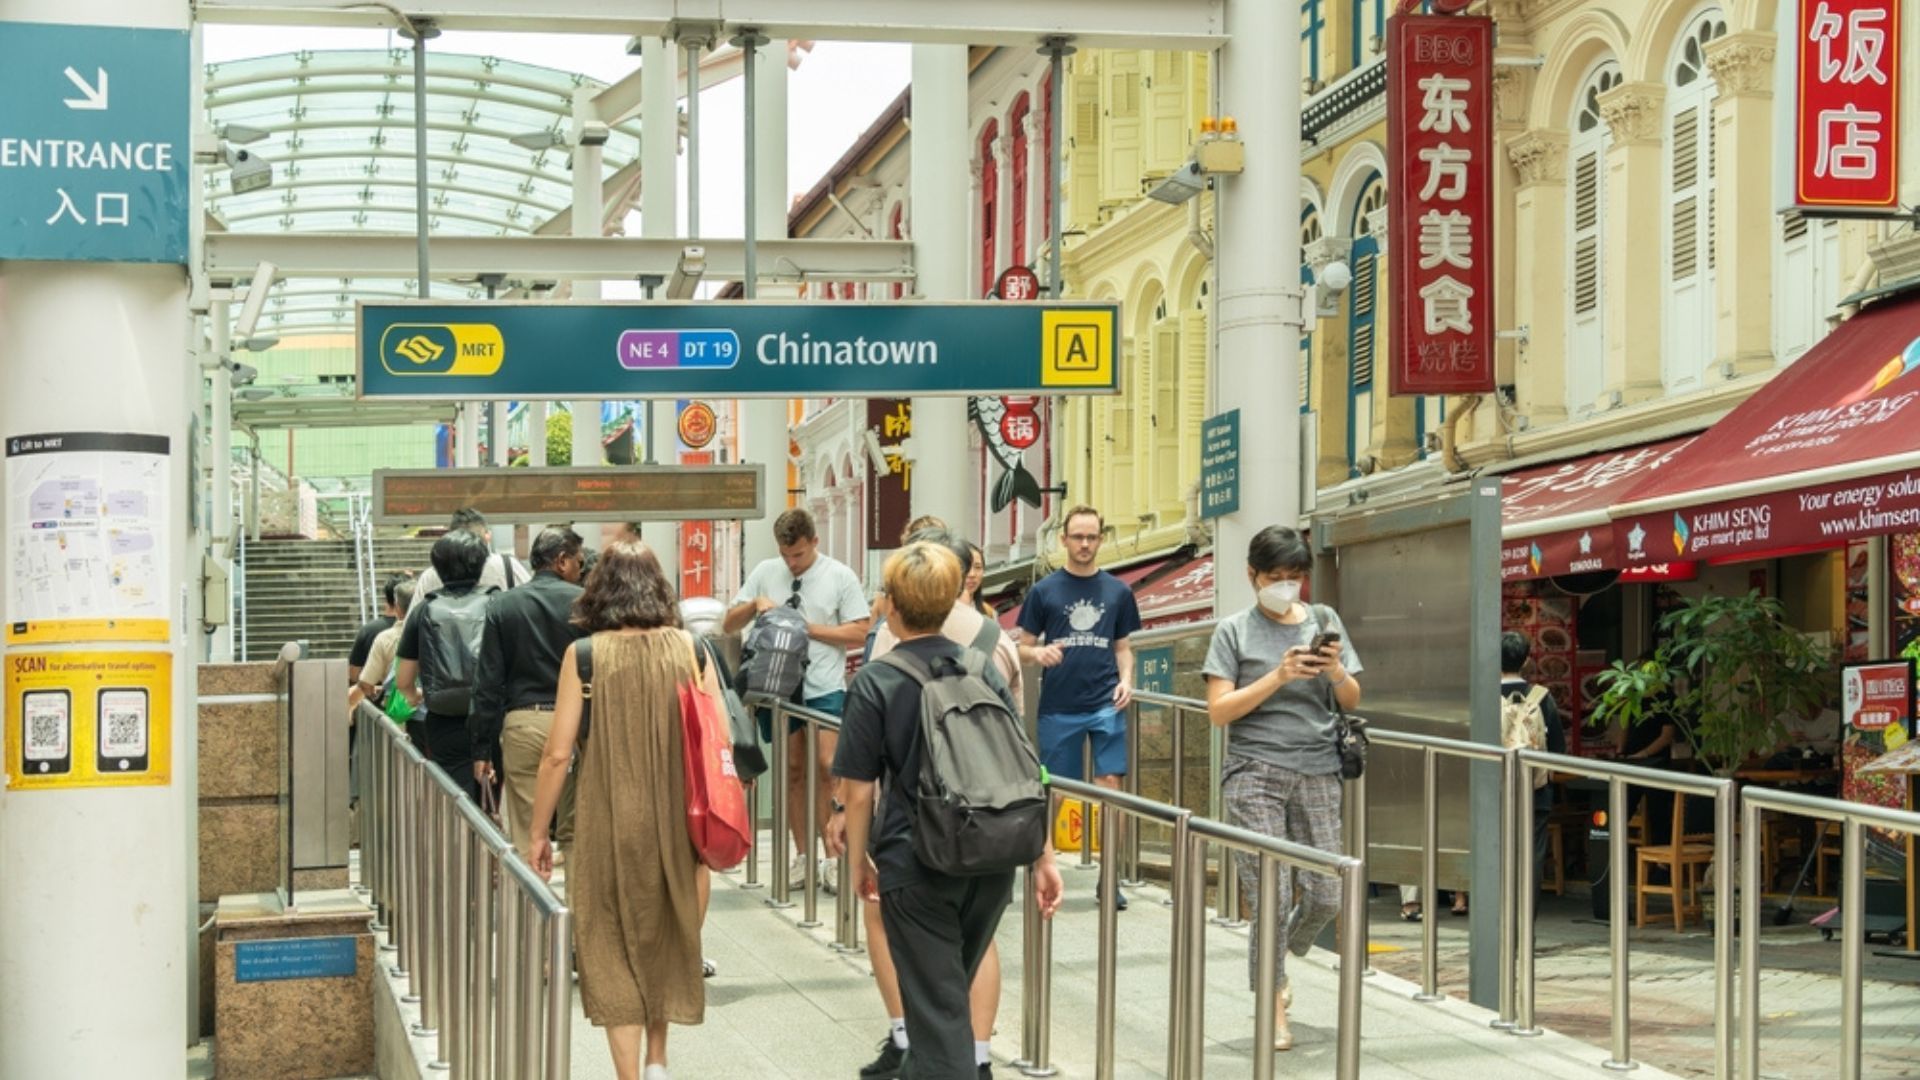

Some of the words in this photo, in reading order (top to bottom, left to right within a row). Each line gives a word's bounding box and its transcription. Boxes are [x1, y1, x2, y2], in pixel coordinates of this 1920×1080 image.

[1415, 34, 1474, 65] BBQ
[1809, 1, 1887, 179] 饭店
[1, 138, 172, 171] ENTRANCE
[46, 187, 129, 226] 入口
[1418, 73, 1474, 334] 东方美食
[462, 343, 496, 357] MRT
[629, 342, 653, 359] NE
[657, 342, 669, 359] 4
[685, 341, 706, 358] DT
[712, 341, 733, 358] 19
[756, 331, 938, 365] Chinatown
[1066, 333, 1087, 362] A
[1418, 341, 1478, 373] 烧烤
[1799, 492, 1832, 511] Your
[1833, 483, 1886, 507] energy
[1693, 512, 1730, 533] KHIM
[1732, 505, 1771, 526] SENG
[1820, 508, 1920, 536] www.khimsen
[1691, 535, 1710, 552] gas
[1710, 529, 1734, 546] mart
[1735, 527, 1753, 546] pte
[1753, 524, 1770, 540] ltd
[15, 656, 47, 673] SCAN
[1144, 659, 1157, 676] EXIT
